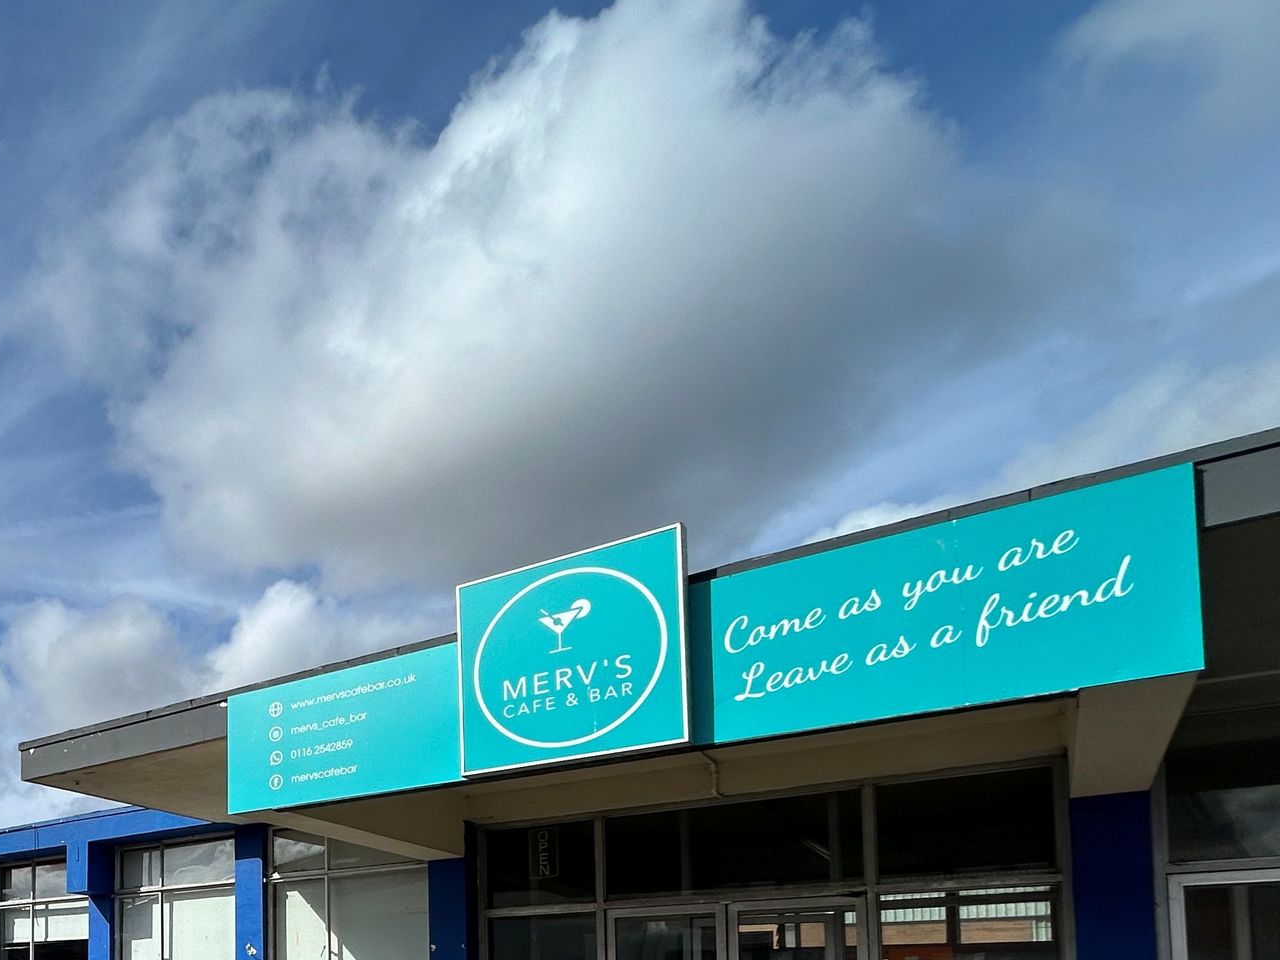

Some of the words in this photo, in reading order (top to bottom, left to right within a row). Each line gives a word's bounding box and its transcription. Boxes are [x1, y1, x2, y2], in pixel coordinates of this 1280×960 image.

[723, 604, 827, 654] Come
[838, 587, 882, 620] as
[902, 560, 984, 611] you
[997, 528, 1080, 573] are
[734, 652, 854, 702] Leave
[865, 633, 916, 666] as
[929, 623, 962, 649] a
[975, 554, 1135, 648] friend
[290, 673, 417, 710] www.mervscafebar.co.uk
[503, 654, 633, 701] MERV'S
[503, 696, 557, 718] CAFE
[565, 692, 579, 707] &
[589, 682, 633, 702] BAR
[290, 711, 368, 735] mervs_cafe_bar
[290, 745, 313, 760] 0116
[314, 739, 354, 755] 2542859
[290, 765, 358, 784] mervscafebar
[538, 831, 550, 876] OPEN
